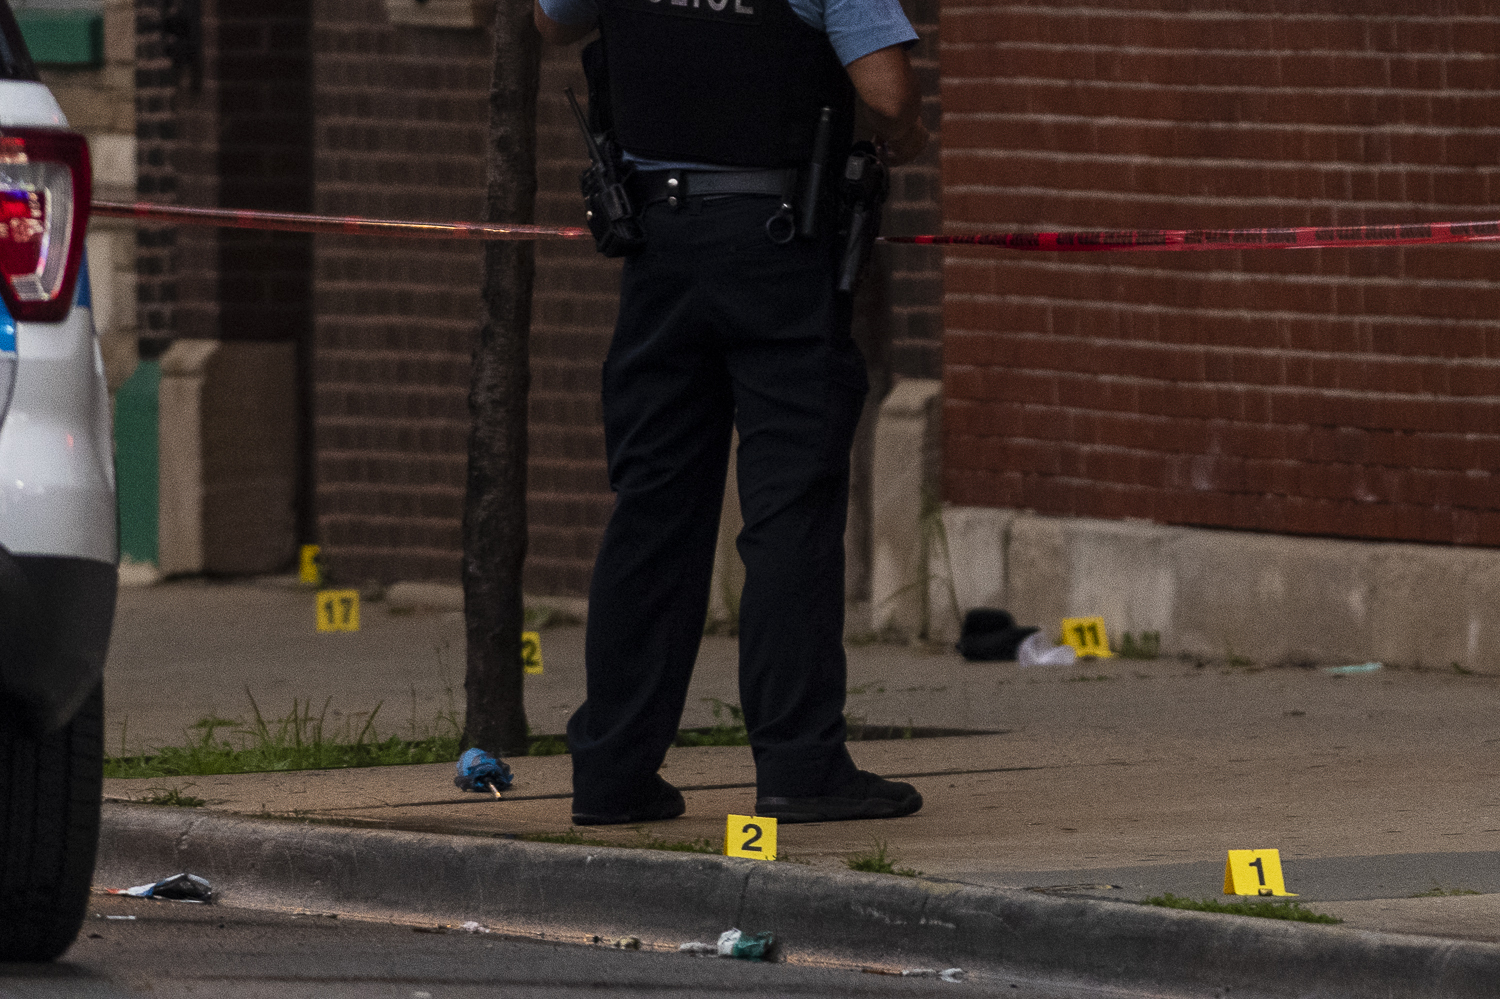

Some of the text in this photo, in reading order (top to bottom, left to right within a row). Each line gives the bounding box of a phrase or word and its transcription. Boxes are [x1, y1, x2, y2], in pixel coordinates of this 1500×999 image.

[325, 597, 352, 624] 17
[1073, 622, 1100, 648] 11
[741, 823, 763, 852] 2
[1248, 857, 1266, 886] 1
